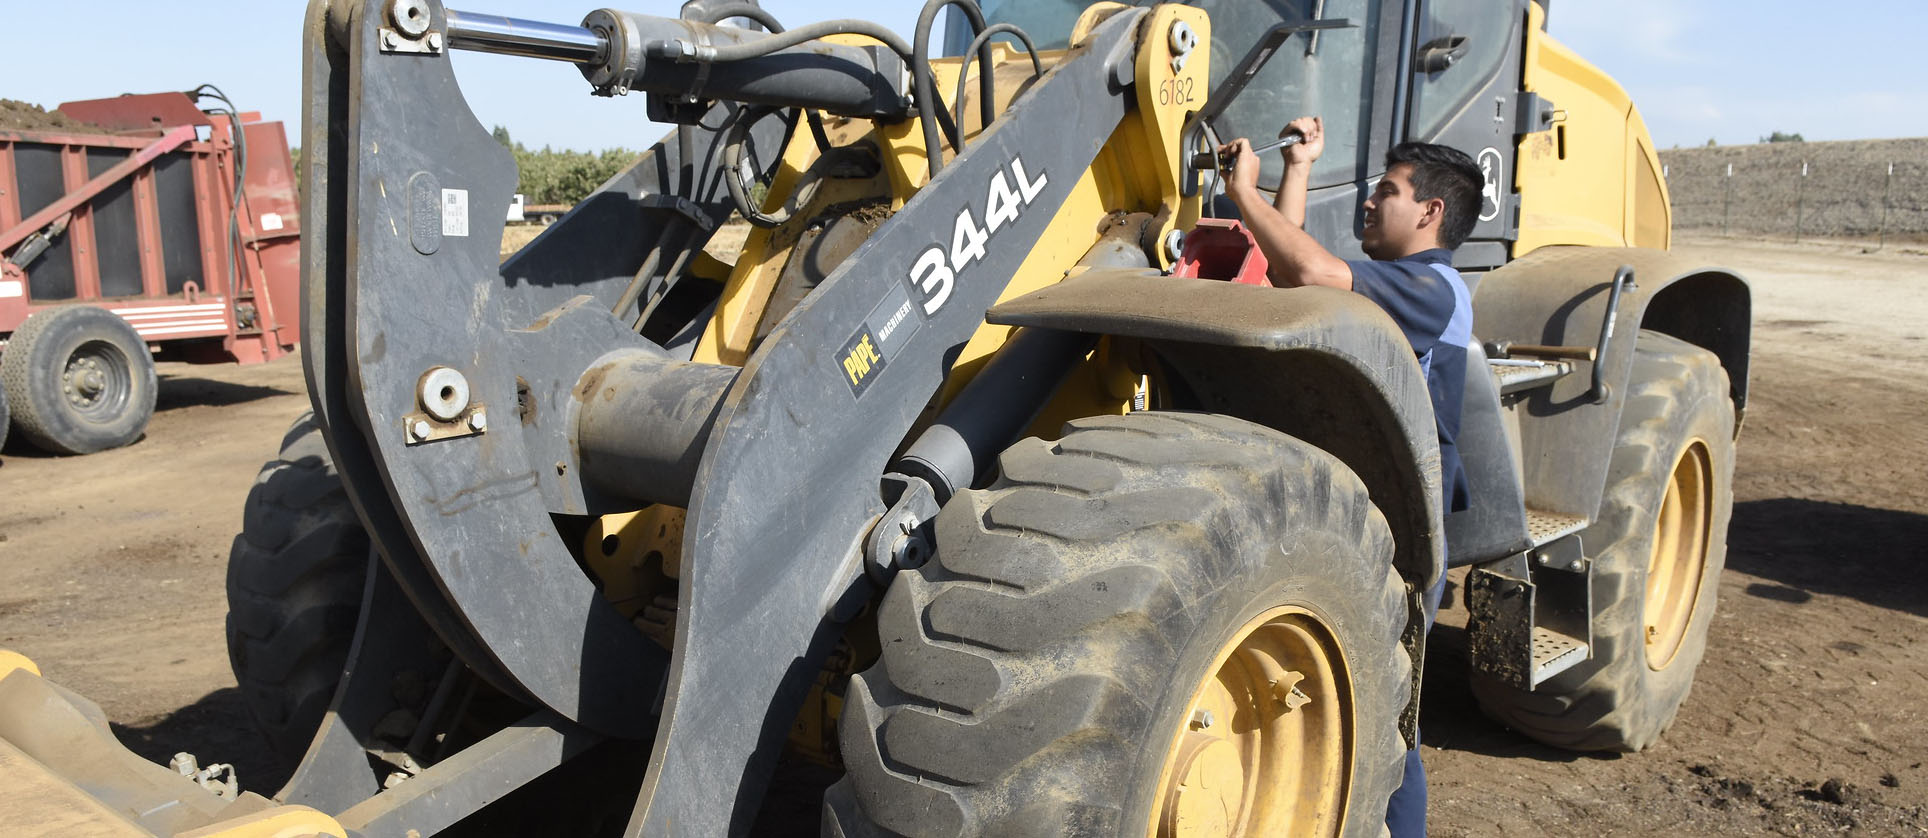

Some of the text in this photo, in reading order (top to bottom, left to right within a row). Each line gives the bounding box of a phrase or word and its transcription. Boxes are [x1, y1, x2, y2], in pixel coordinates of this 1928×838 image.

[1159, 77, 1194, 106] 6182
[909, 157, 1048, 316] 344L
[878, 299, 912, 342] MACHINERY
